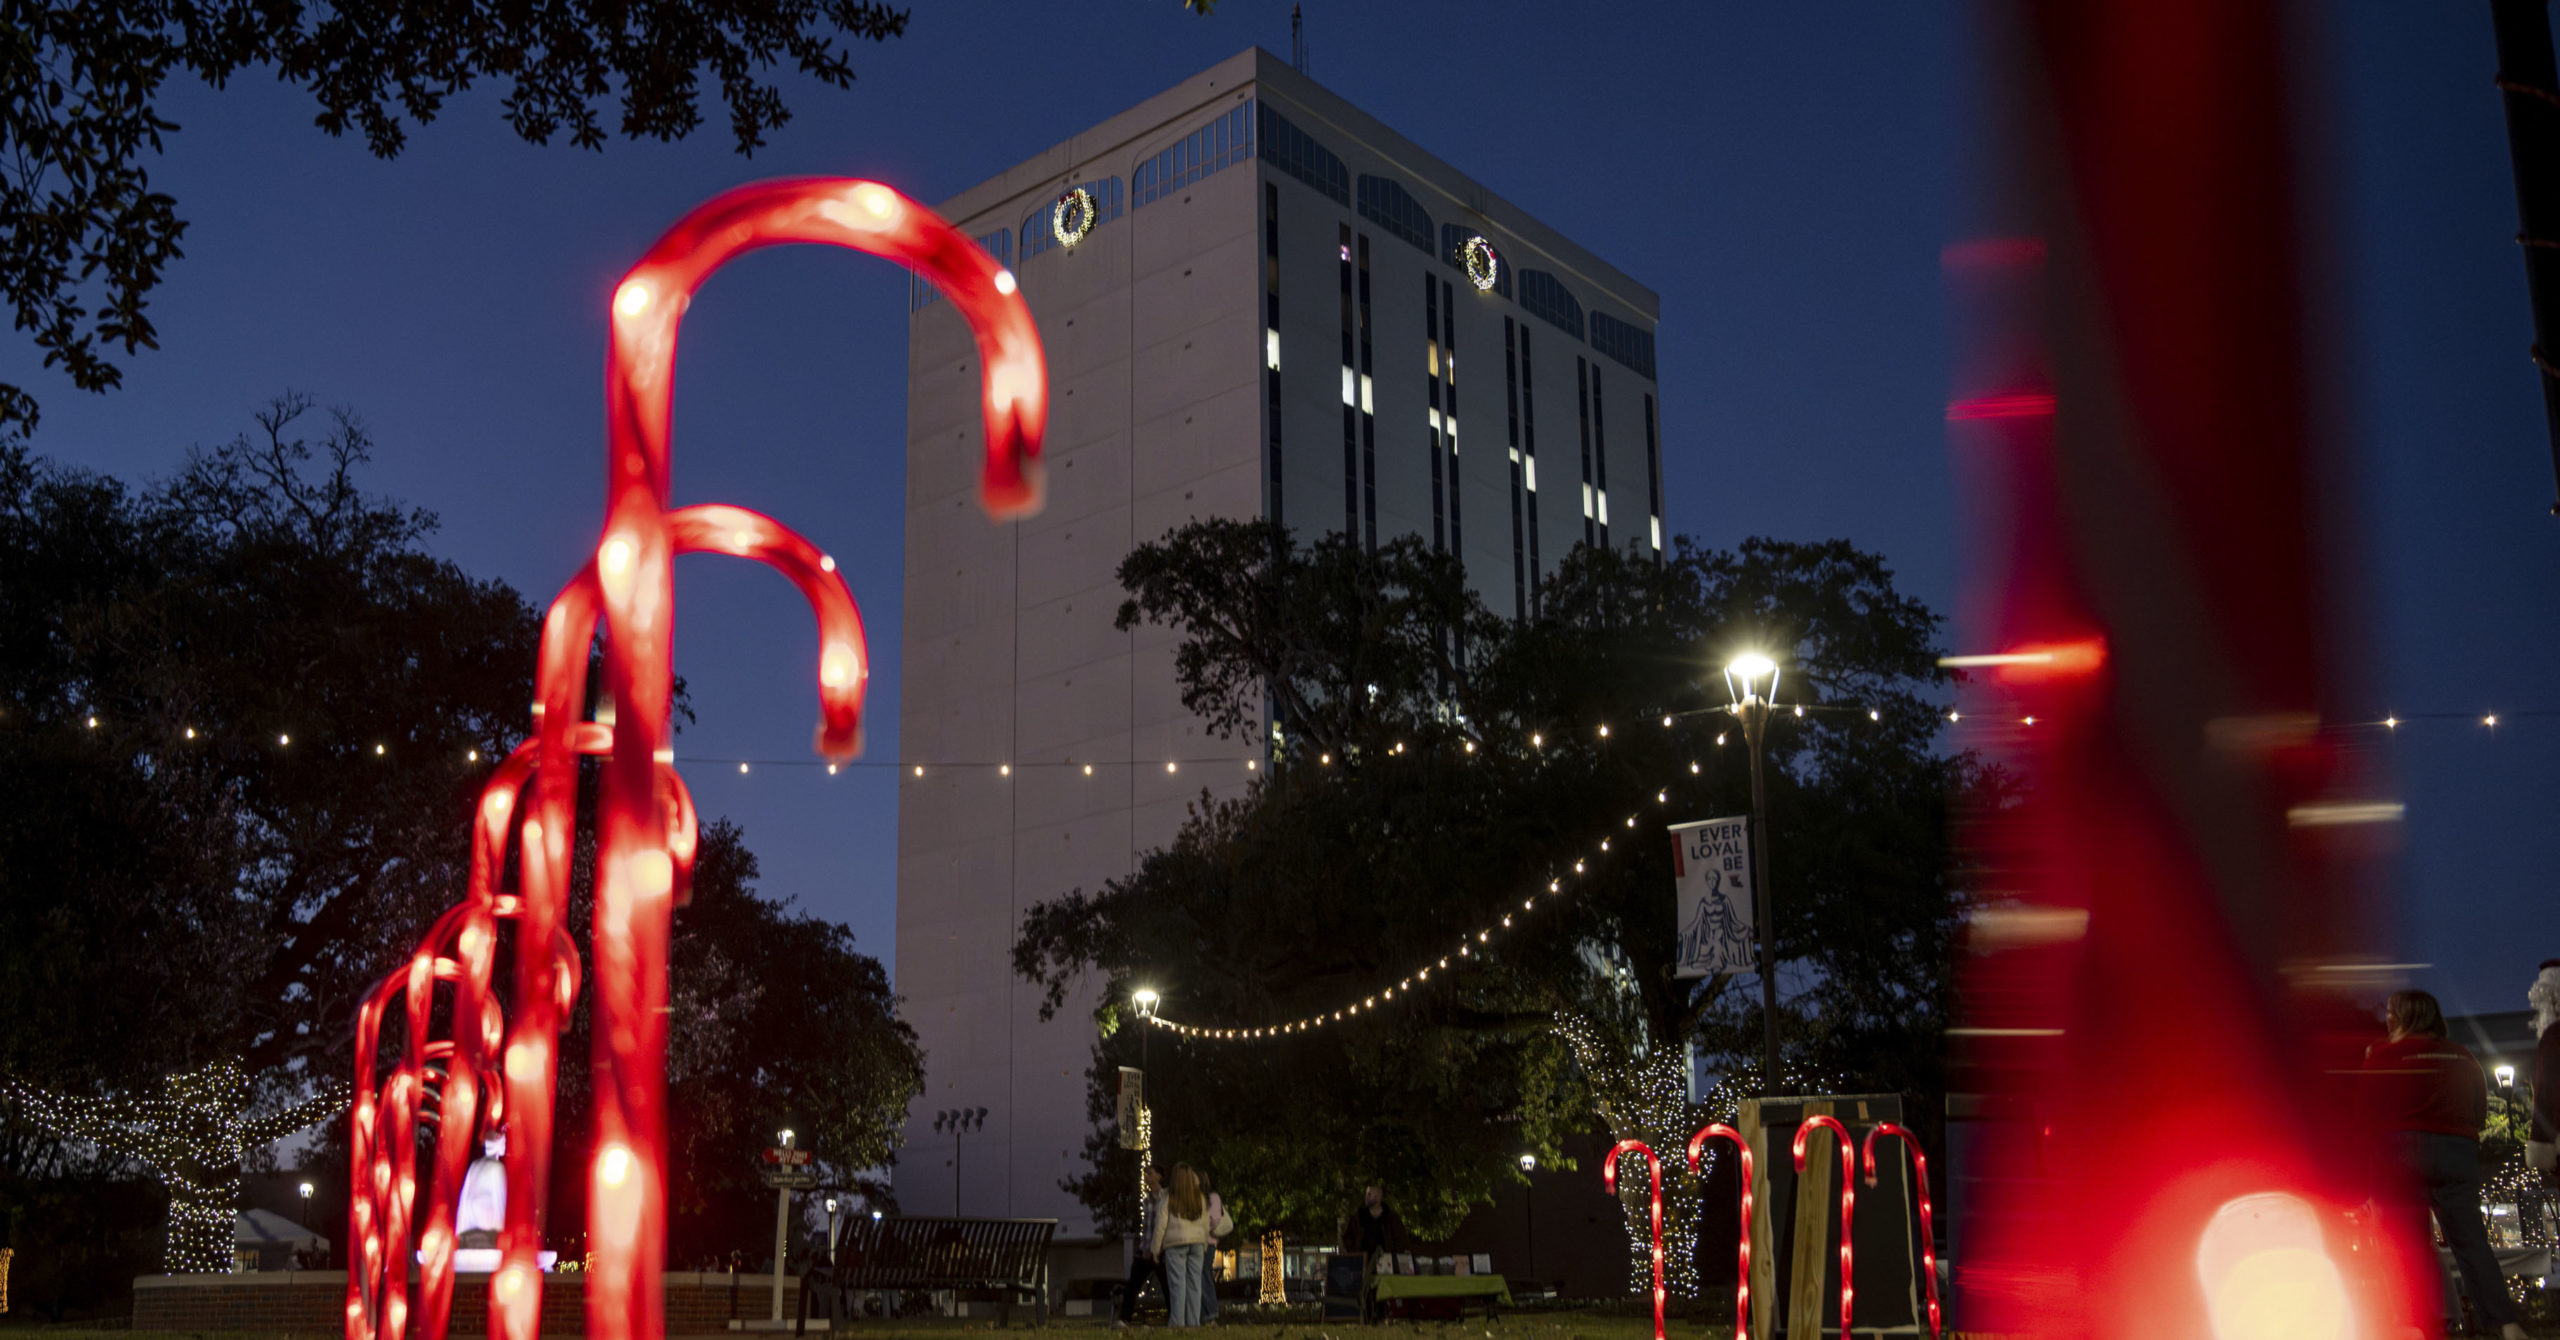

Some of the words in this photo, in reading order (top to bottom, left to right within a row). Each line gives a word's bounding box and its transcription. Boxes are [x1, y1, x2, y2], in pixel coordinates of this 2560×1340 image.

[1700, 824, 1742, 842] EVER
[1691, 841, 1744, 860] LOYAL
[1723, 856, 1744, 871] BE
